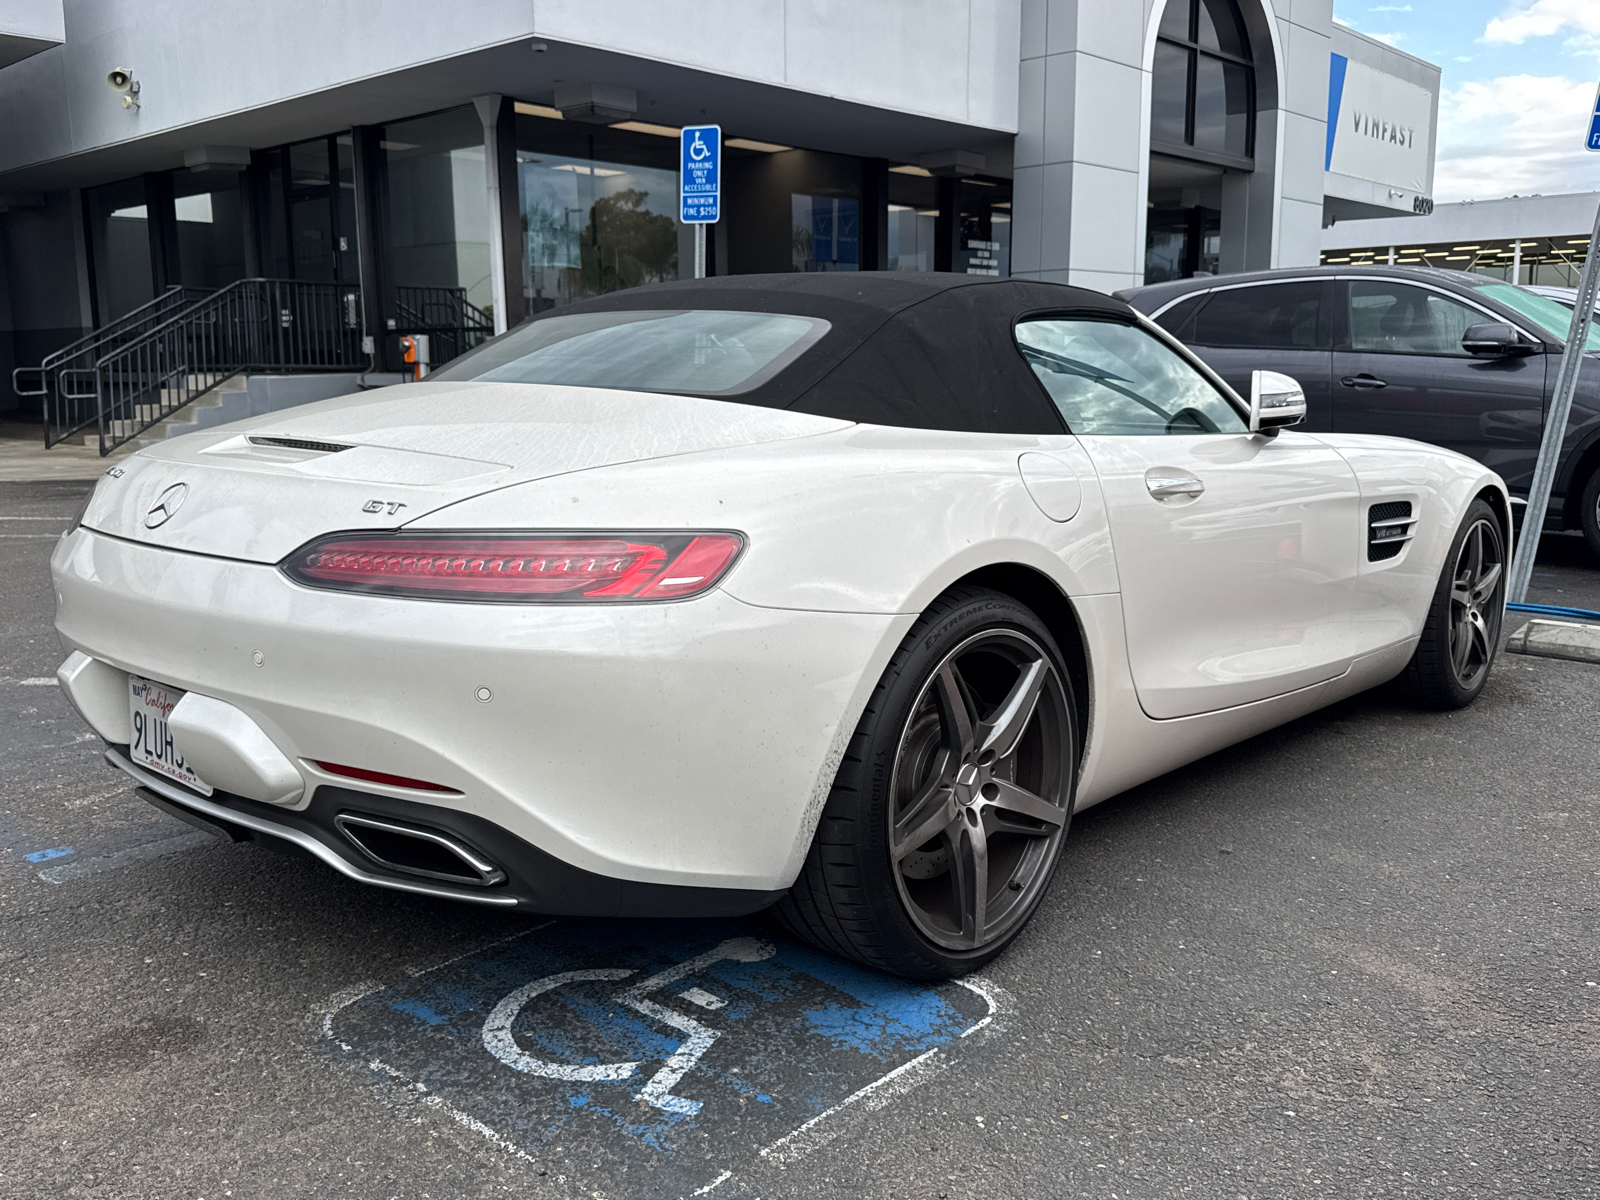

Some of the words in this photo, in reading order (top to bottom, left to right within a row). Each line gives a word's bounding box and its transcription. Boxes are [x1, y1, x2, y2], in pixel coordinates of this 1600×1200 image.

[1353, 109, 1414, 149] VINFAST
[688, 161, 713, 170] PARKING
[684, 184, 716, 192] ACCESSIBLE
[687, 197, 714, 206] MINIMUM
[1413, 195, 1434, 215] 8020
[684, 208, 698, 216] FINE
[700, 206, 716, 216] $250
[362, 500, 407, 515] GT
[132, 684, 143, 698] MAY
